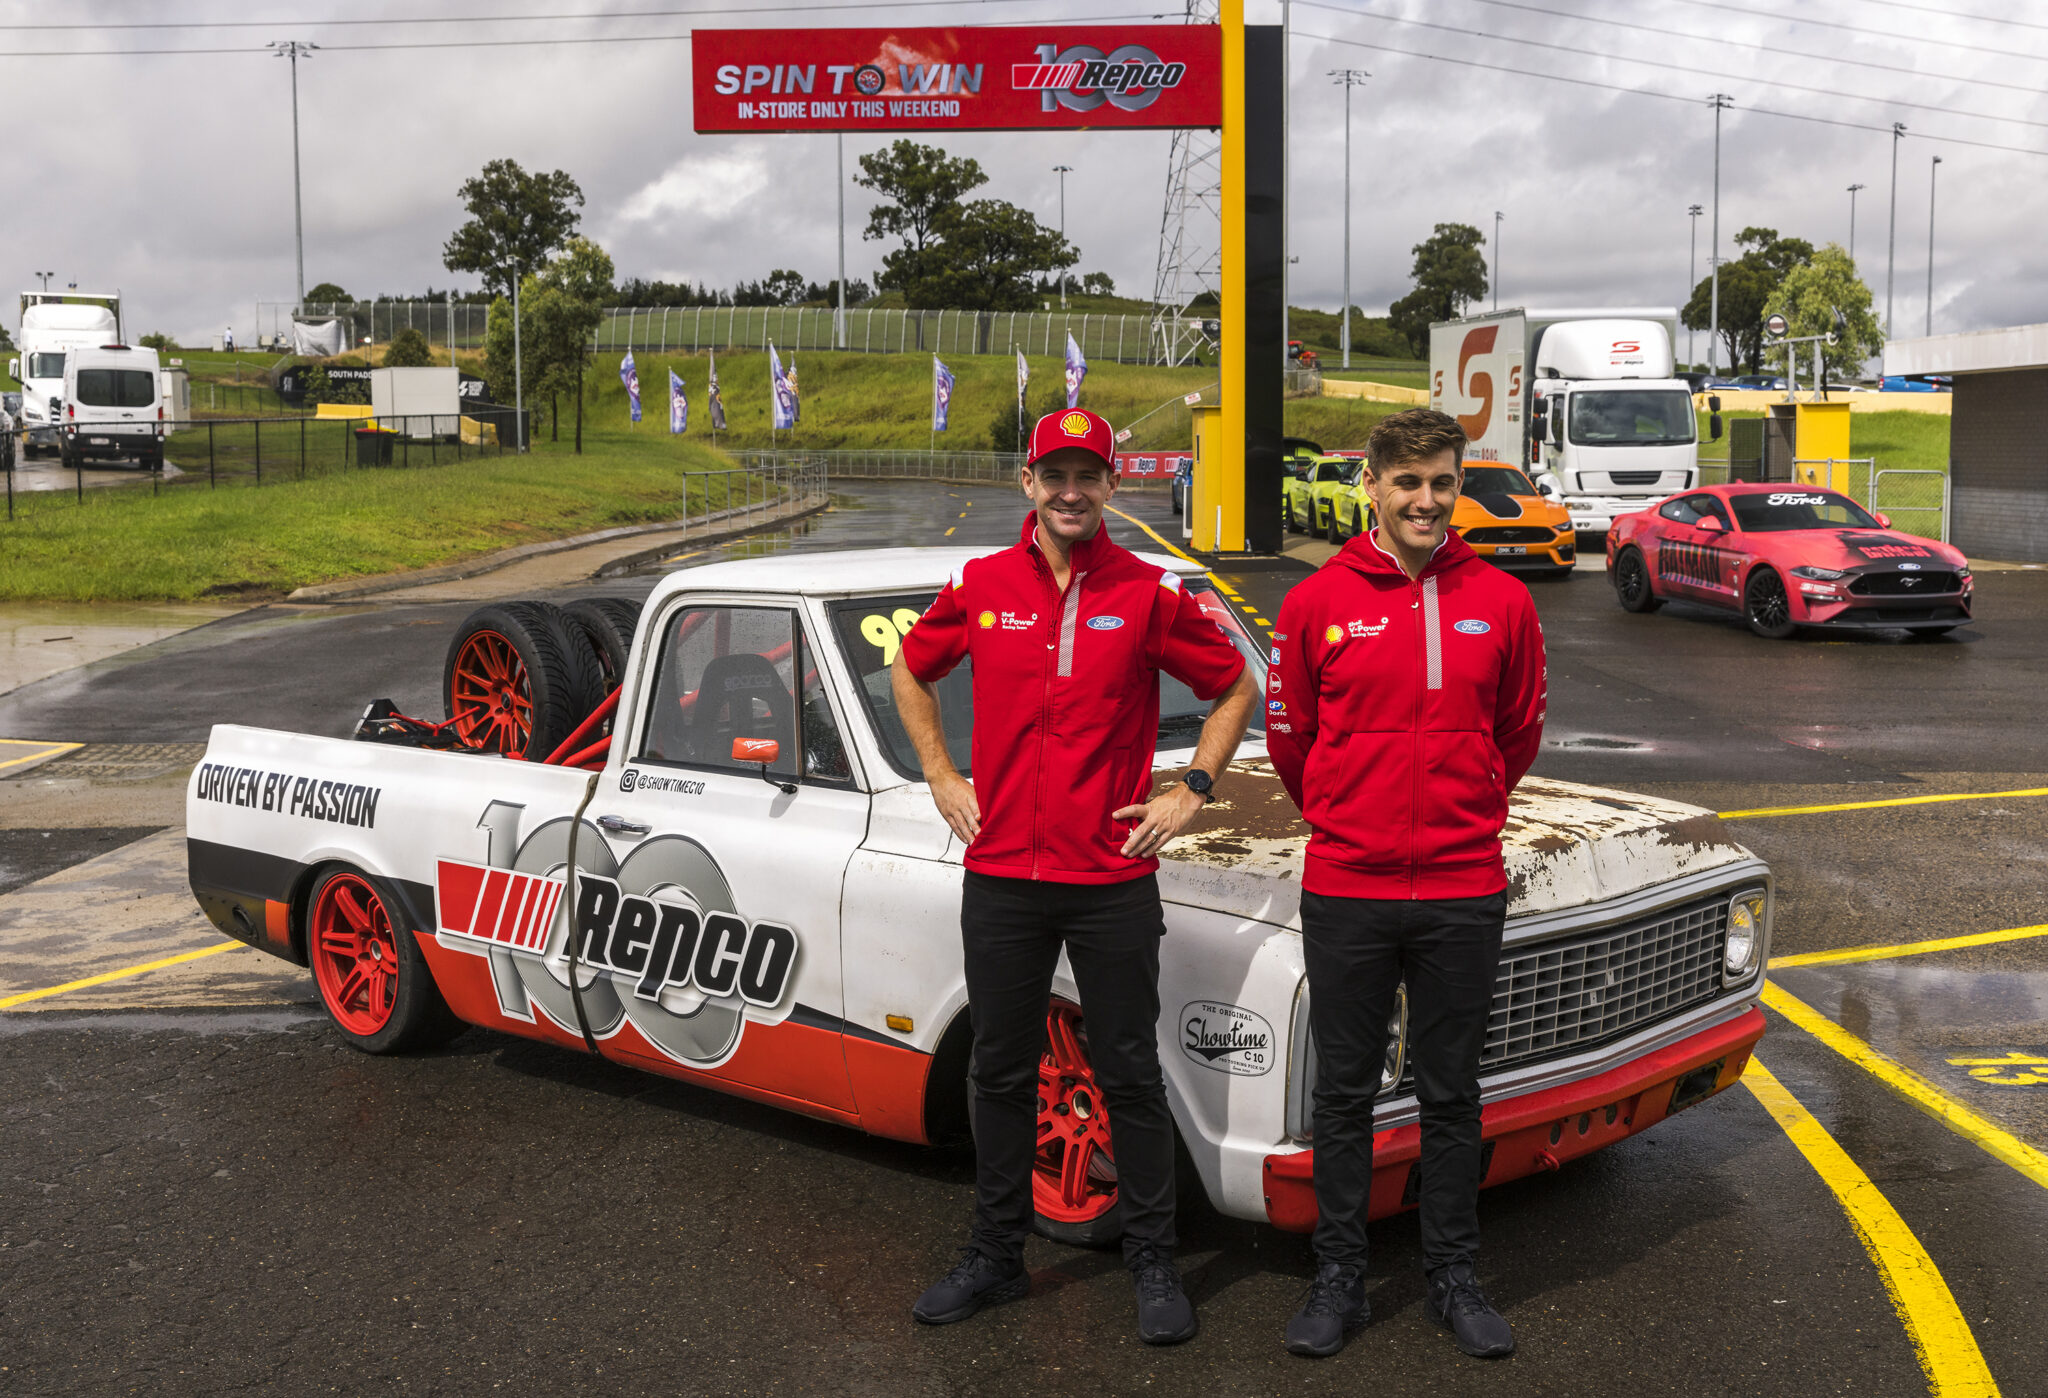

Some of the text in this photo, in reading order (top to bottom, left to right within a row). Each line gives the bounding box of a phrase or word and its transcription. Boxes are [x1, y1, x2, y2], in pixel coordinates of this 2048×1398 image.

[714, 64, 816, 95] SPIN
[899, 63, 984, 95] WIN
[1076, 60, 1187, 95] Repco
[738, 100, 960, 119] IN-STORE ONLY THIS WEEKEND
[328, 370, 372, 379] SOUTH PADD
[1138, 458, 1156, 473] Repco
[1767, 493, 1827, 505] Ford
[1001, 618, 1035, 626] V-Power
[1093, 617, 1117, 628] Ford
[1349, 624, 1386, 633] V-Power
[1461, 621, 1484, 631] Ford
[1271, 722, 1291, 730] coles
[638, 775, 705, 795] @SHOWTIMEC10
[197, 763, 381, 829] DRIVEN BY PASSION
[561, 872, 797, 1005] Repco
[1202, 1005, 1253, 1021] THE ORIGINAL
[1185, 1017, 1268, 1049] Showtime
[1244, 1051, 1264, 1063] C 10
